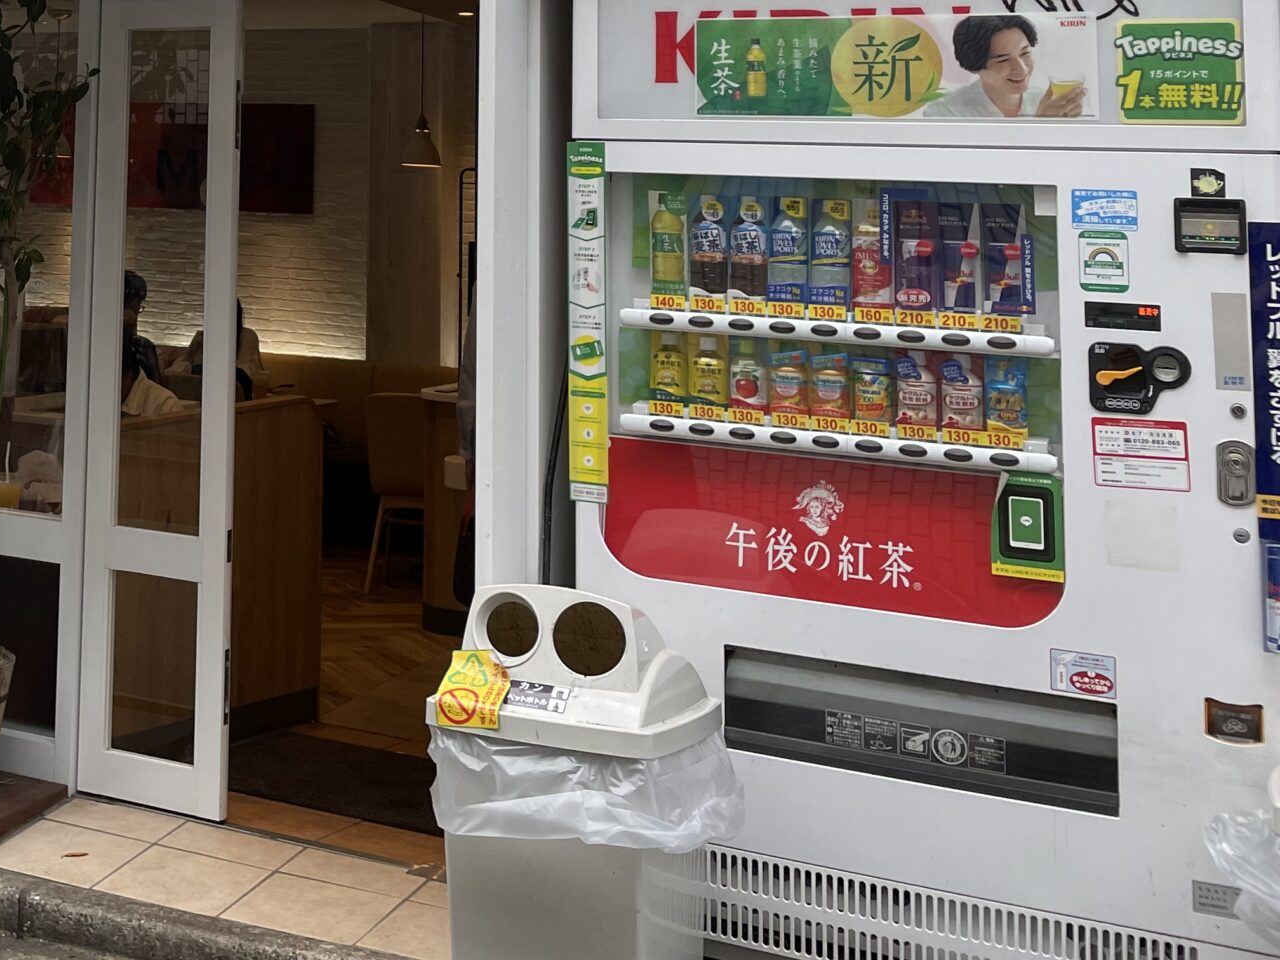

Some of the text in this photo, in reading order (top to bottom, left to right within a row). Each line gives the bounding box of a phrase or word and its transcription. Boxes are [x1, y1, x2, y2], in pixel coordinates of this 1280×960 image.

[1114, 30, 1243, 59] Tappiness
[710, 39, 740, 96] 生茶
[852, 33, 923, 102] 新
[1149, 70, 1209, 79] 15ポイントで
[654, 296, 682, 308] 140円
[695, 298, 721, 310] 130円
[734, 301, 762, 313] 130円
[773, 304, 801, 316] 130円
[813, 306, 842, 319] 130円
[860, 310, 889, 322] 160円
[900, 312, 931, 325] 210円
[942, 315, 974, 328] 210円
[984, 317, 1017, 330] 210円
[653, 403, 680, 415] 130円
[693, 406, 721, 419] 130円
[733, 410, 760, 423] 130円
[777, 415, 805, 427] 130円
[817, 419, 845, 431] 130円
[855, 422, 886, 435] 130円
[902, 427, 933, 439] 130円
[947, 431, 978, 443] 130円
[987, 434, 1019, 447] 130円
[726, 522, 915, 588] 午後の紅茶
[519, 681, 544, 692] カン
[507, 693, 549, 707] ペットボトル
